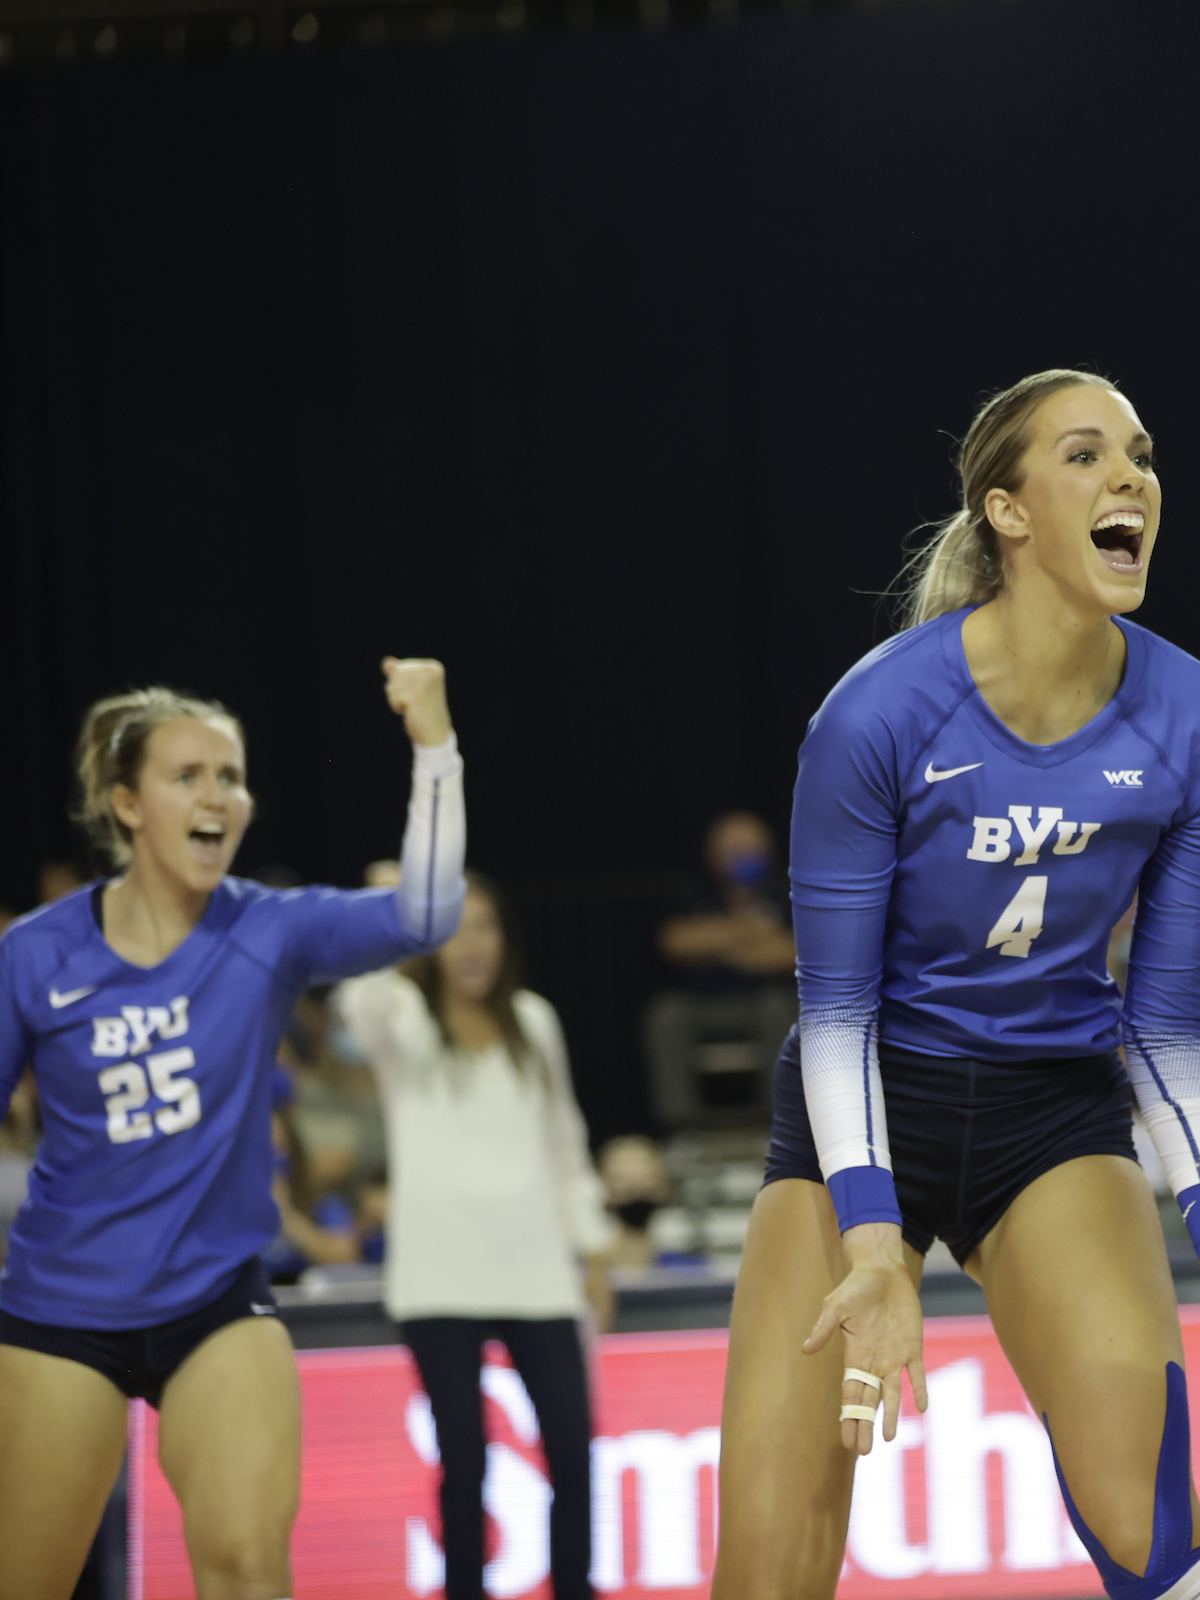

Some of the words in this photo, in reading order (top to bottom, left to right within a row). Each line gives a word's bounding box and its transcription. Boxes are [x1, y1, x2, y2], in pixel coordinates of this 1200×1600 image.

[1102, 769, 1144, 786] WCC
[966, 804, 1102, 867] BYU
[985, 875, 1049, 959] 4
[91, 995, 190, 1057] BYU
[97, 1045, 201, 1144] 25
[404, 1356, 1116, 1599] Smth
